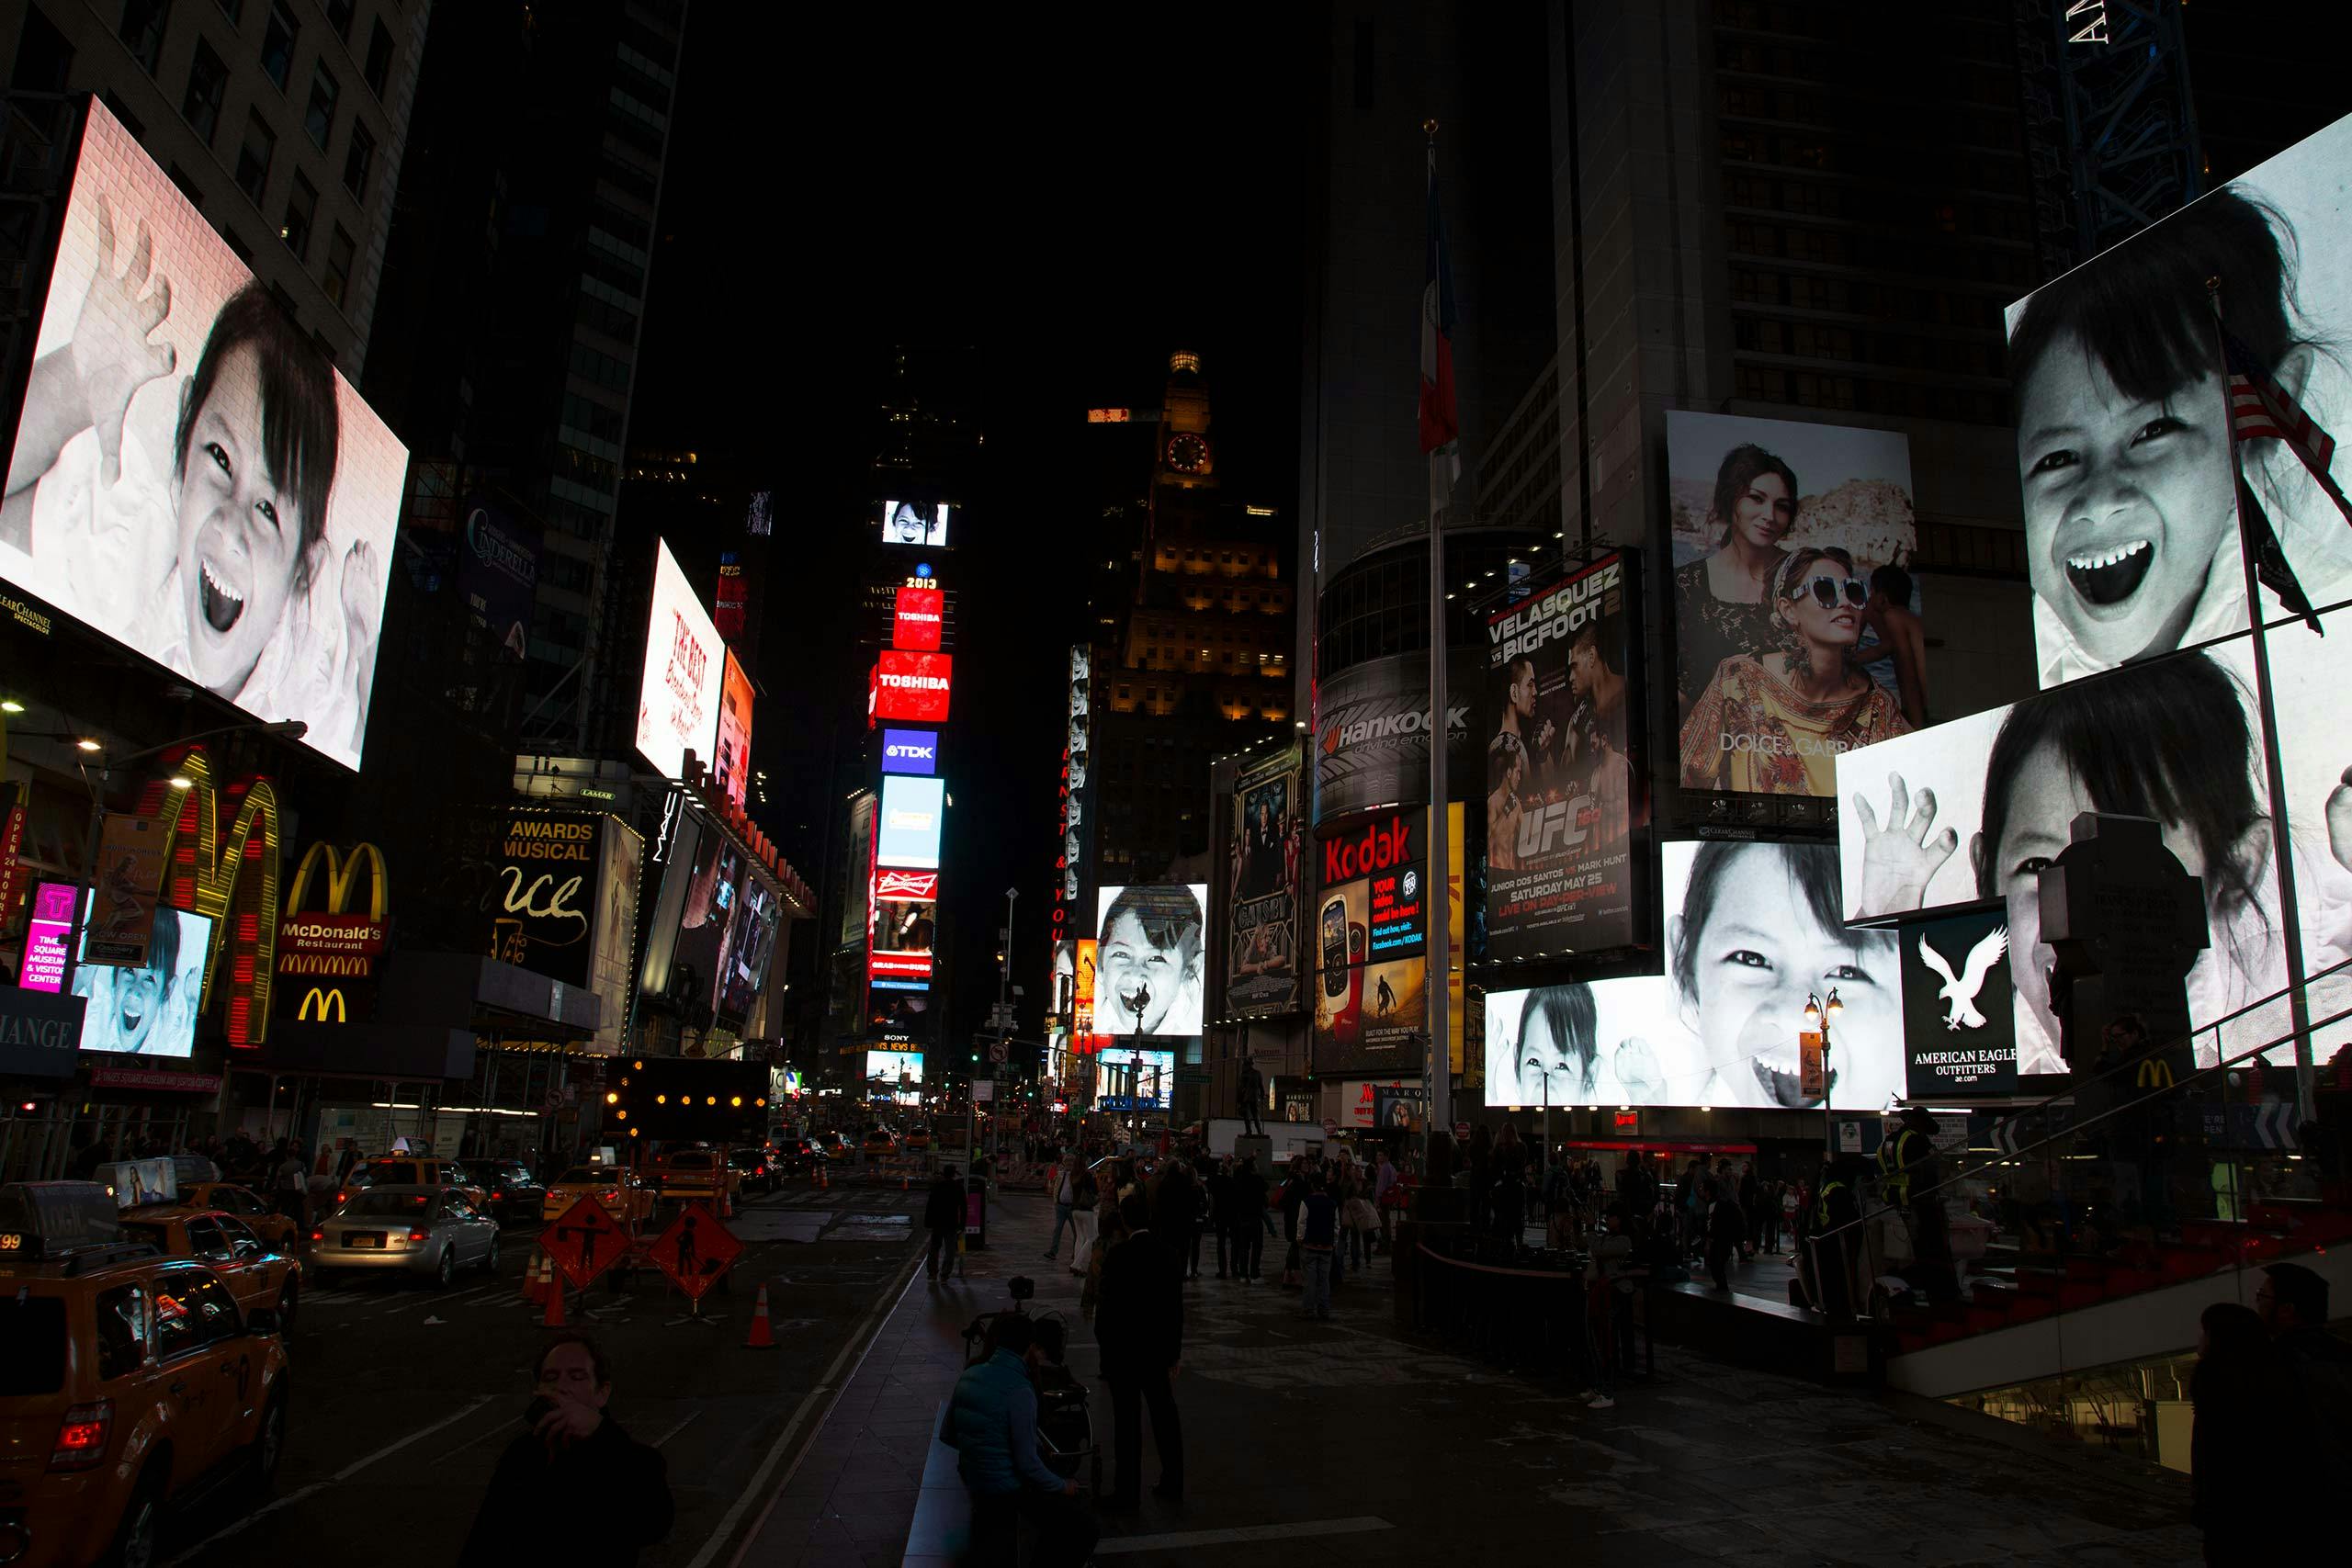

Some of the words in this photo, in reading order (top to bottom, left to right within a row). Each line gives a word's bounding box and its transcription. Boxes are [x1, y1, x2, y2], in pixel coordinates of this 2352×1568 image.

[907, 577, 937, 590] 2013
[1488, 562, 1620, 644] VELASQUEZ
[899, 612, 940, 622] TOSHIBA
[1503, 598, 1601, 664] BIGFOOT
[880, 674, 949, 690] TOSHIBA
[1354, 739, 1398, 754] driving
[1400, 730, 1468, 744] emoon
[1721, 733, 1783, 755] DOLCE
[897, 745, 933, 759] TDK
[582, 789, 613, 800] LAMAR
[8, 813, 22, 853] OPEN
[510, 820, 594, 840] AWARDS
[1517, 795, 1590, 858] UFC
[504, 840, 591, 861] MUSICAL
[1325, 815, 1412, 885] Kodak
[5, 857, 16, 867] 24
[1491, 880, 1515, 893] JUNIOR
[1516, 875, 1532, 887] DOS
[1532, 868, 1564, 883] SANTOS
[1577, 859, 1601, 873] MARK
[1603, 852, 1627, 866] HUNT
[879, 877, 934, 888] Budweiser
[1374, 876, 1396, 894] YOUR
[1510, 881, 1563, 903] SATURDAY
[1564, 875, 1587, 891] MAY
[1588, 872, 1602, 886] 25
[1499, 903, 1521, 918] LIVE
[1522, 899, 1537, 912] ON
[119, 931, 147, 941] OPEN
[281, 922, 382, 941] McDonald's
[40, 936, 61, 945] TIME
[297, 939, 363, 950] Restaurant
[33, 945, 66, 956] SQUARE
[27, 964, 34, 973] &
[28, 974, 62, 985] CENTER
[891, 1043, 908, 1052] NEWS
[1915, 1050, 1976, 1066] AMERICAN
[1979, 1047, 2017, 1062] EAGLE
[1936, 1064, 1996, 1077] OUTFITTERS
[1954, 1075, 1978, 1083] ae.com
